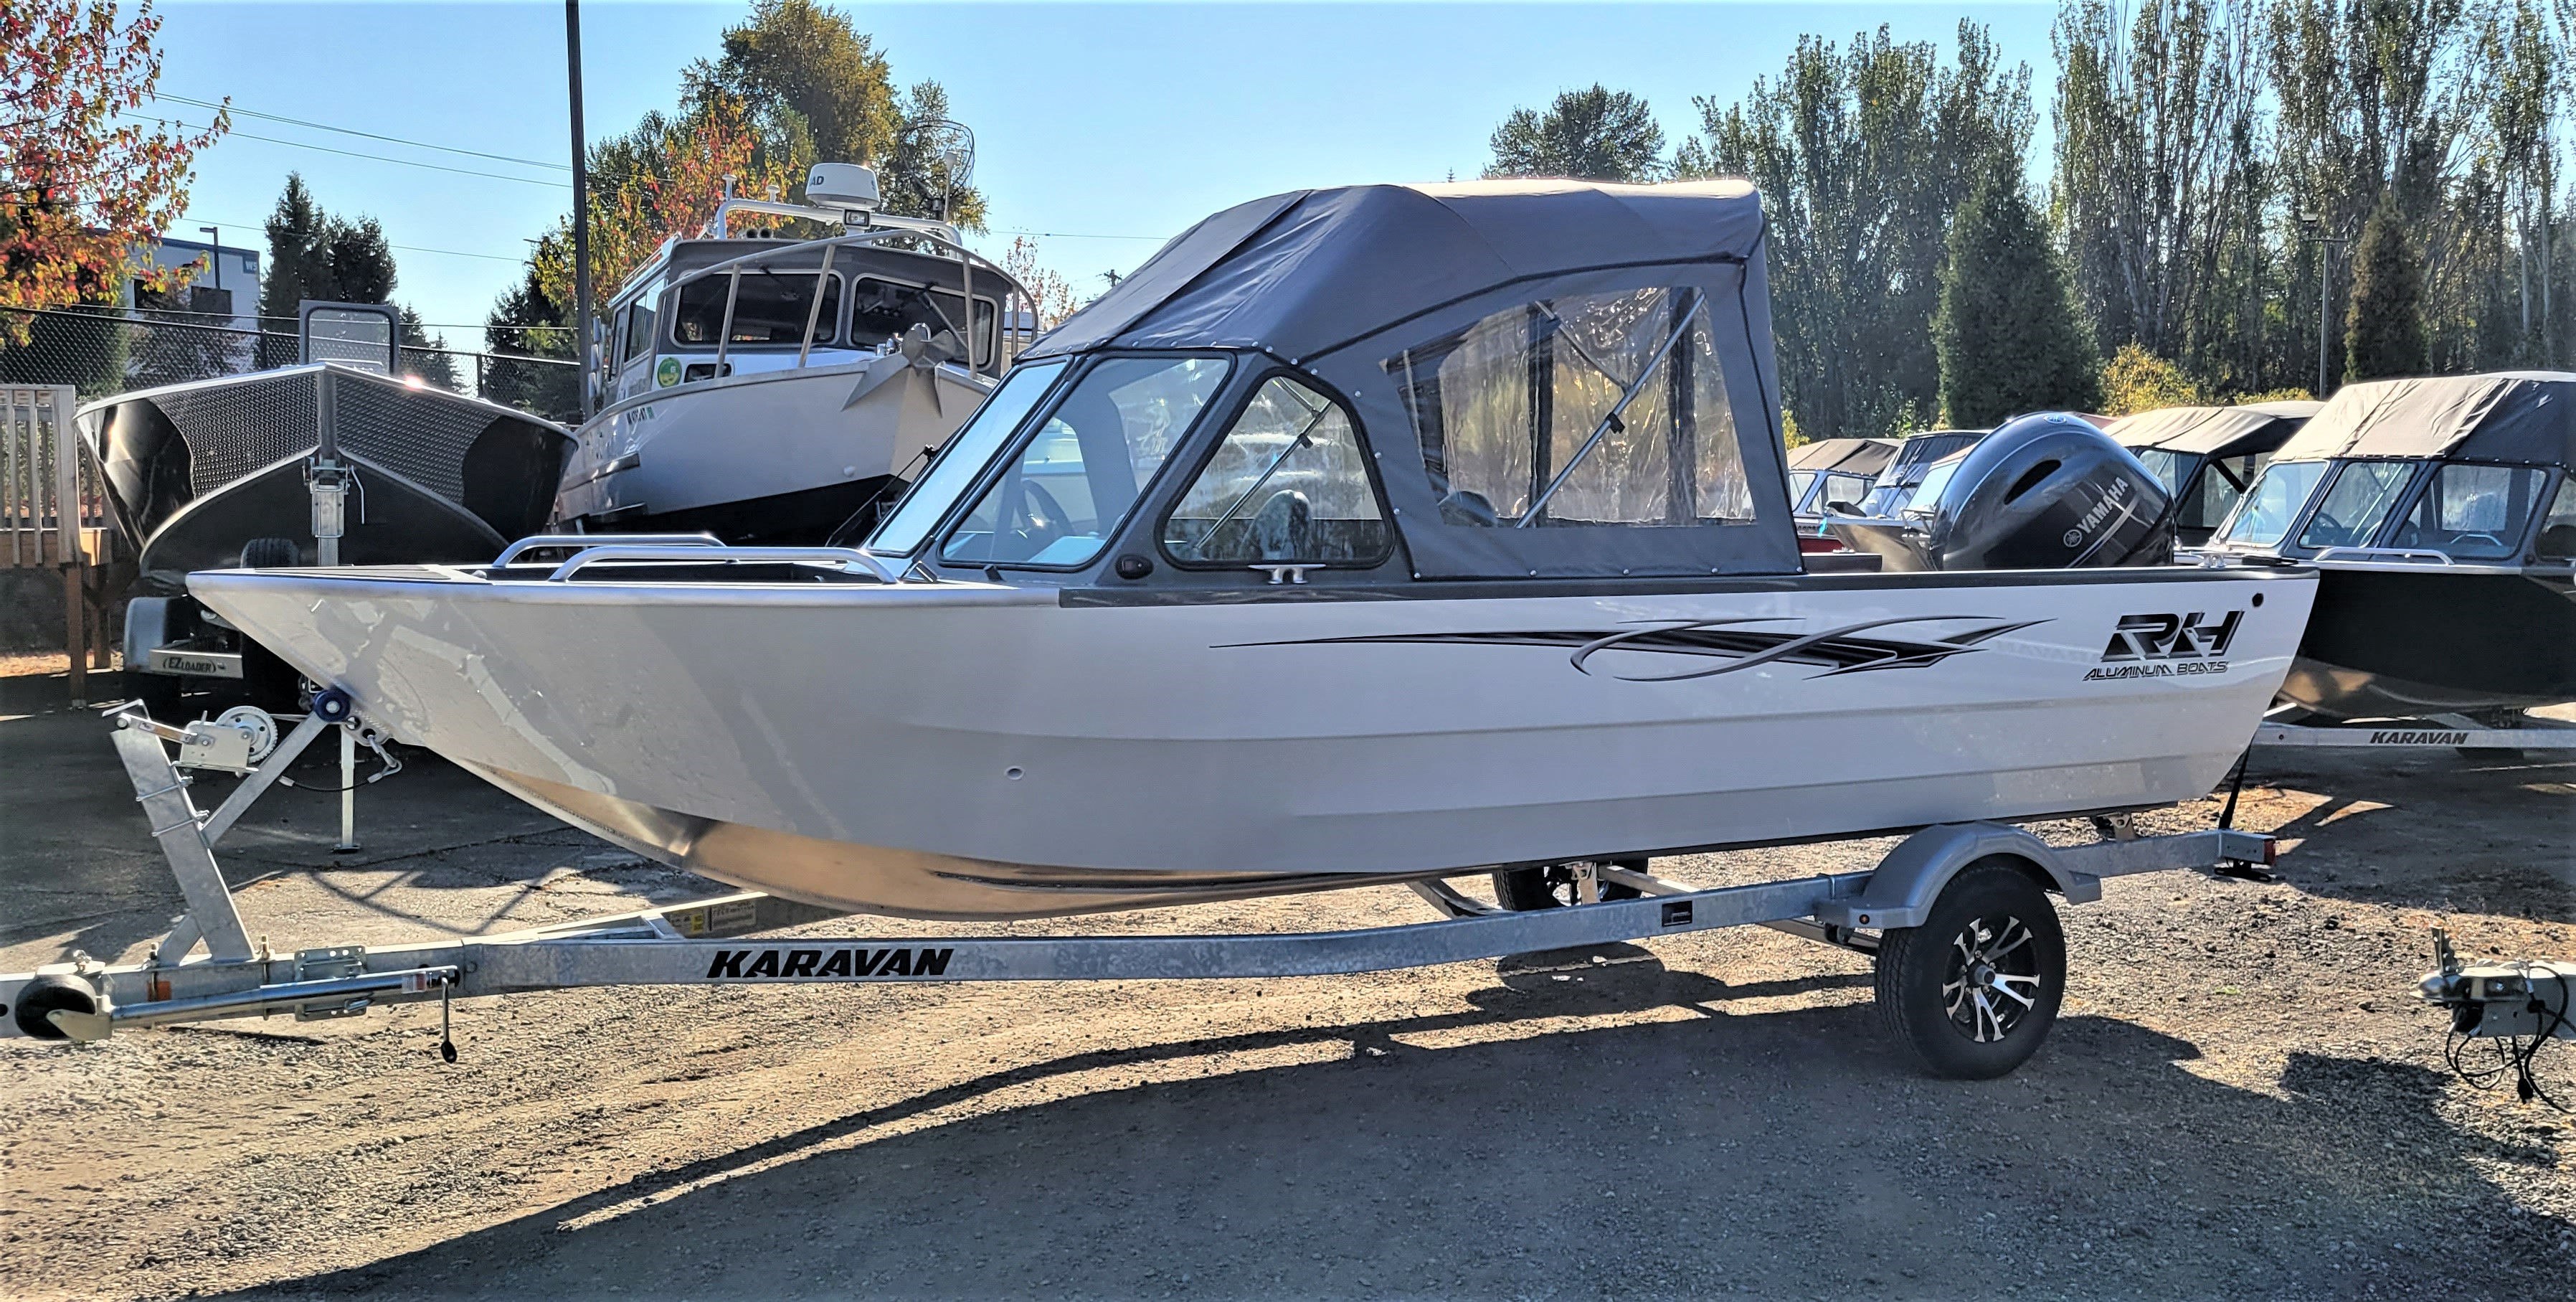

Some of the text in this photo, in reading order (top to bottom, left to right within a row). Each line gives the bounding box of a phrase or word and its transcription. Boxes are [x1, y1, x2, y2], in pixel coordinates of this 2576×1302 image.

[2076, 476, 2128, 534] YAMAHA
[2101, 610, 2245, 663] RH
[2082, 661, 2230, 681] ALUMINUM BOATS
[2369, 732, 2470, 745] KARAVAN
[706, 948, 955, 978] KARAVAN
